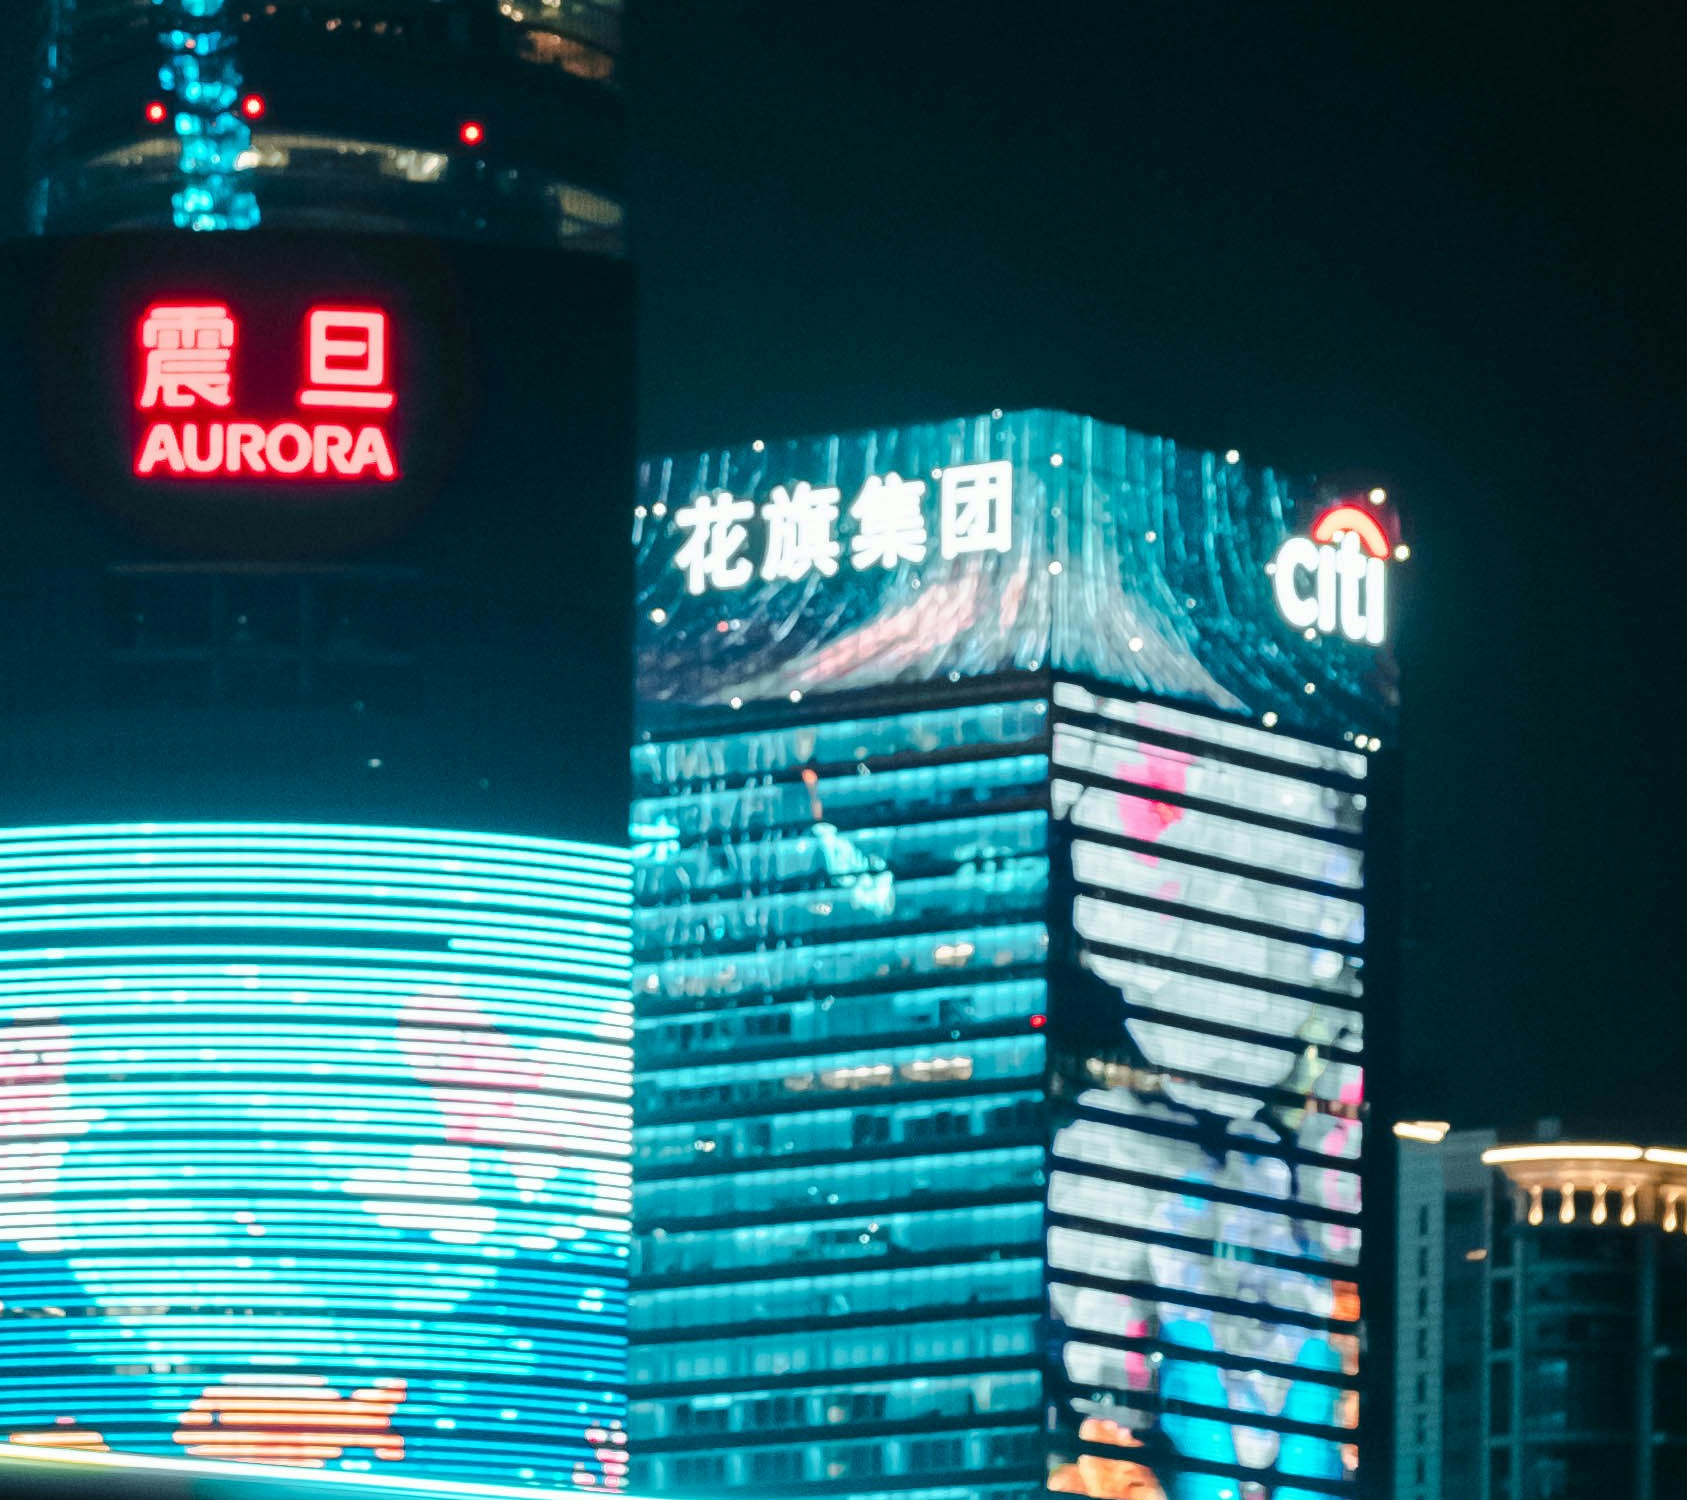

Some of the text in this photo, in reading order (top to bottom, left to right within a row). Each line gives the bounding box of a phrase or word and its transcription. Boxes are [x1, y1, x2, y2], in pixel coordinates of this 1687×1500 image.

[139, 305, 395, 409] 震旦
[138, 422, 396, 476] AURORA
[674, 460, 1014, 596] 花旗集团
